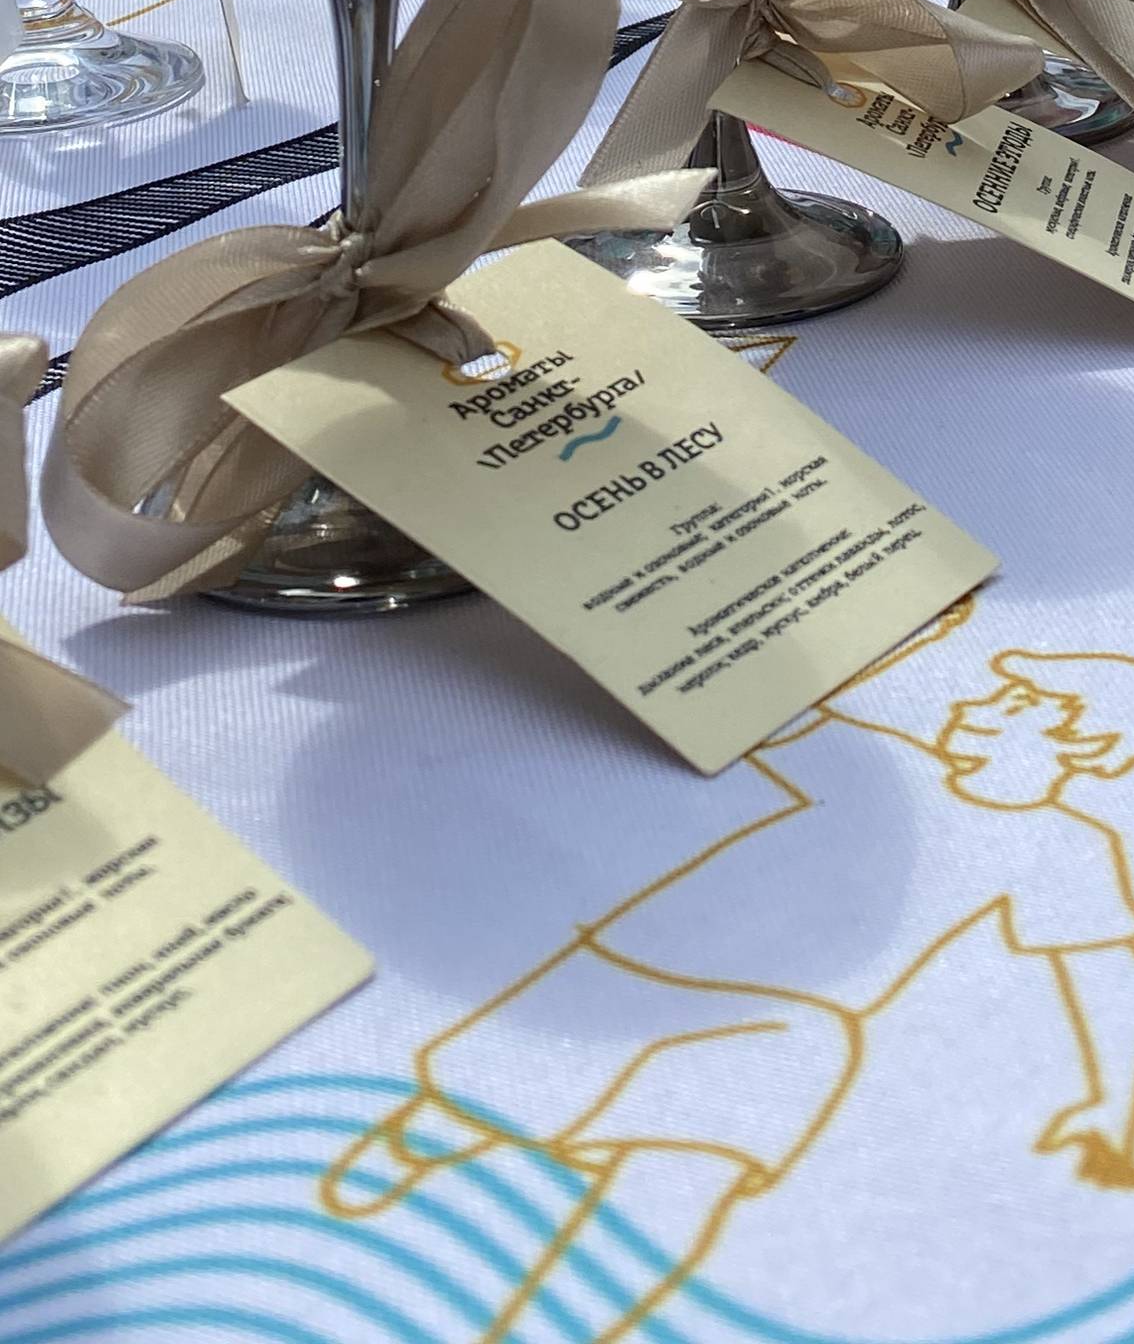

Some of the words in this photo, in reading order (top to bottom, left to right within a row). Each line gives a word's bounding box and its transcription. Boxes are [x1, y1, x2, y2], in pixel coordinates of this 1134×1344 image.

[855, 91, 896, 130] Ароматы
[885, 108, 917, 136] Санкт-
[994, 120, 1033, 165] ЭТЮДЫ
[972, 156, 1017, 214] ОСЕННИЕ
[448, 349, 575, 421] Ароматы
[488, 375, 582, 430] Санкт-
[553, 474, 648, 532] ОСЕНЬ
[637, 460, 666, 481] В
[655, 421, 723, 471] ЛЕСУ
[779, 456, 829, 488] морская
[669, 502, 723, 536] Группа:
[834, 527, 891, 566] лаванды,
[887, 503, 927, 529] лотос,
[614, 575, 679, 613] свежесть,
[677, 540, 727, 574] водные
[734, 500, 792, 538] озоновые
[687, 575, 782, 637] Ароматическое
[779, 529, 853, 578] наполнение:
[843, 551, 885, 582] белый
